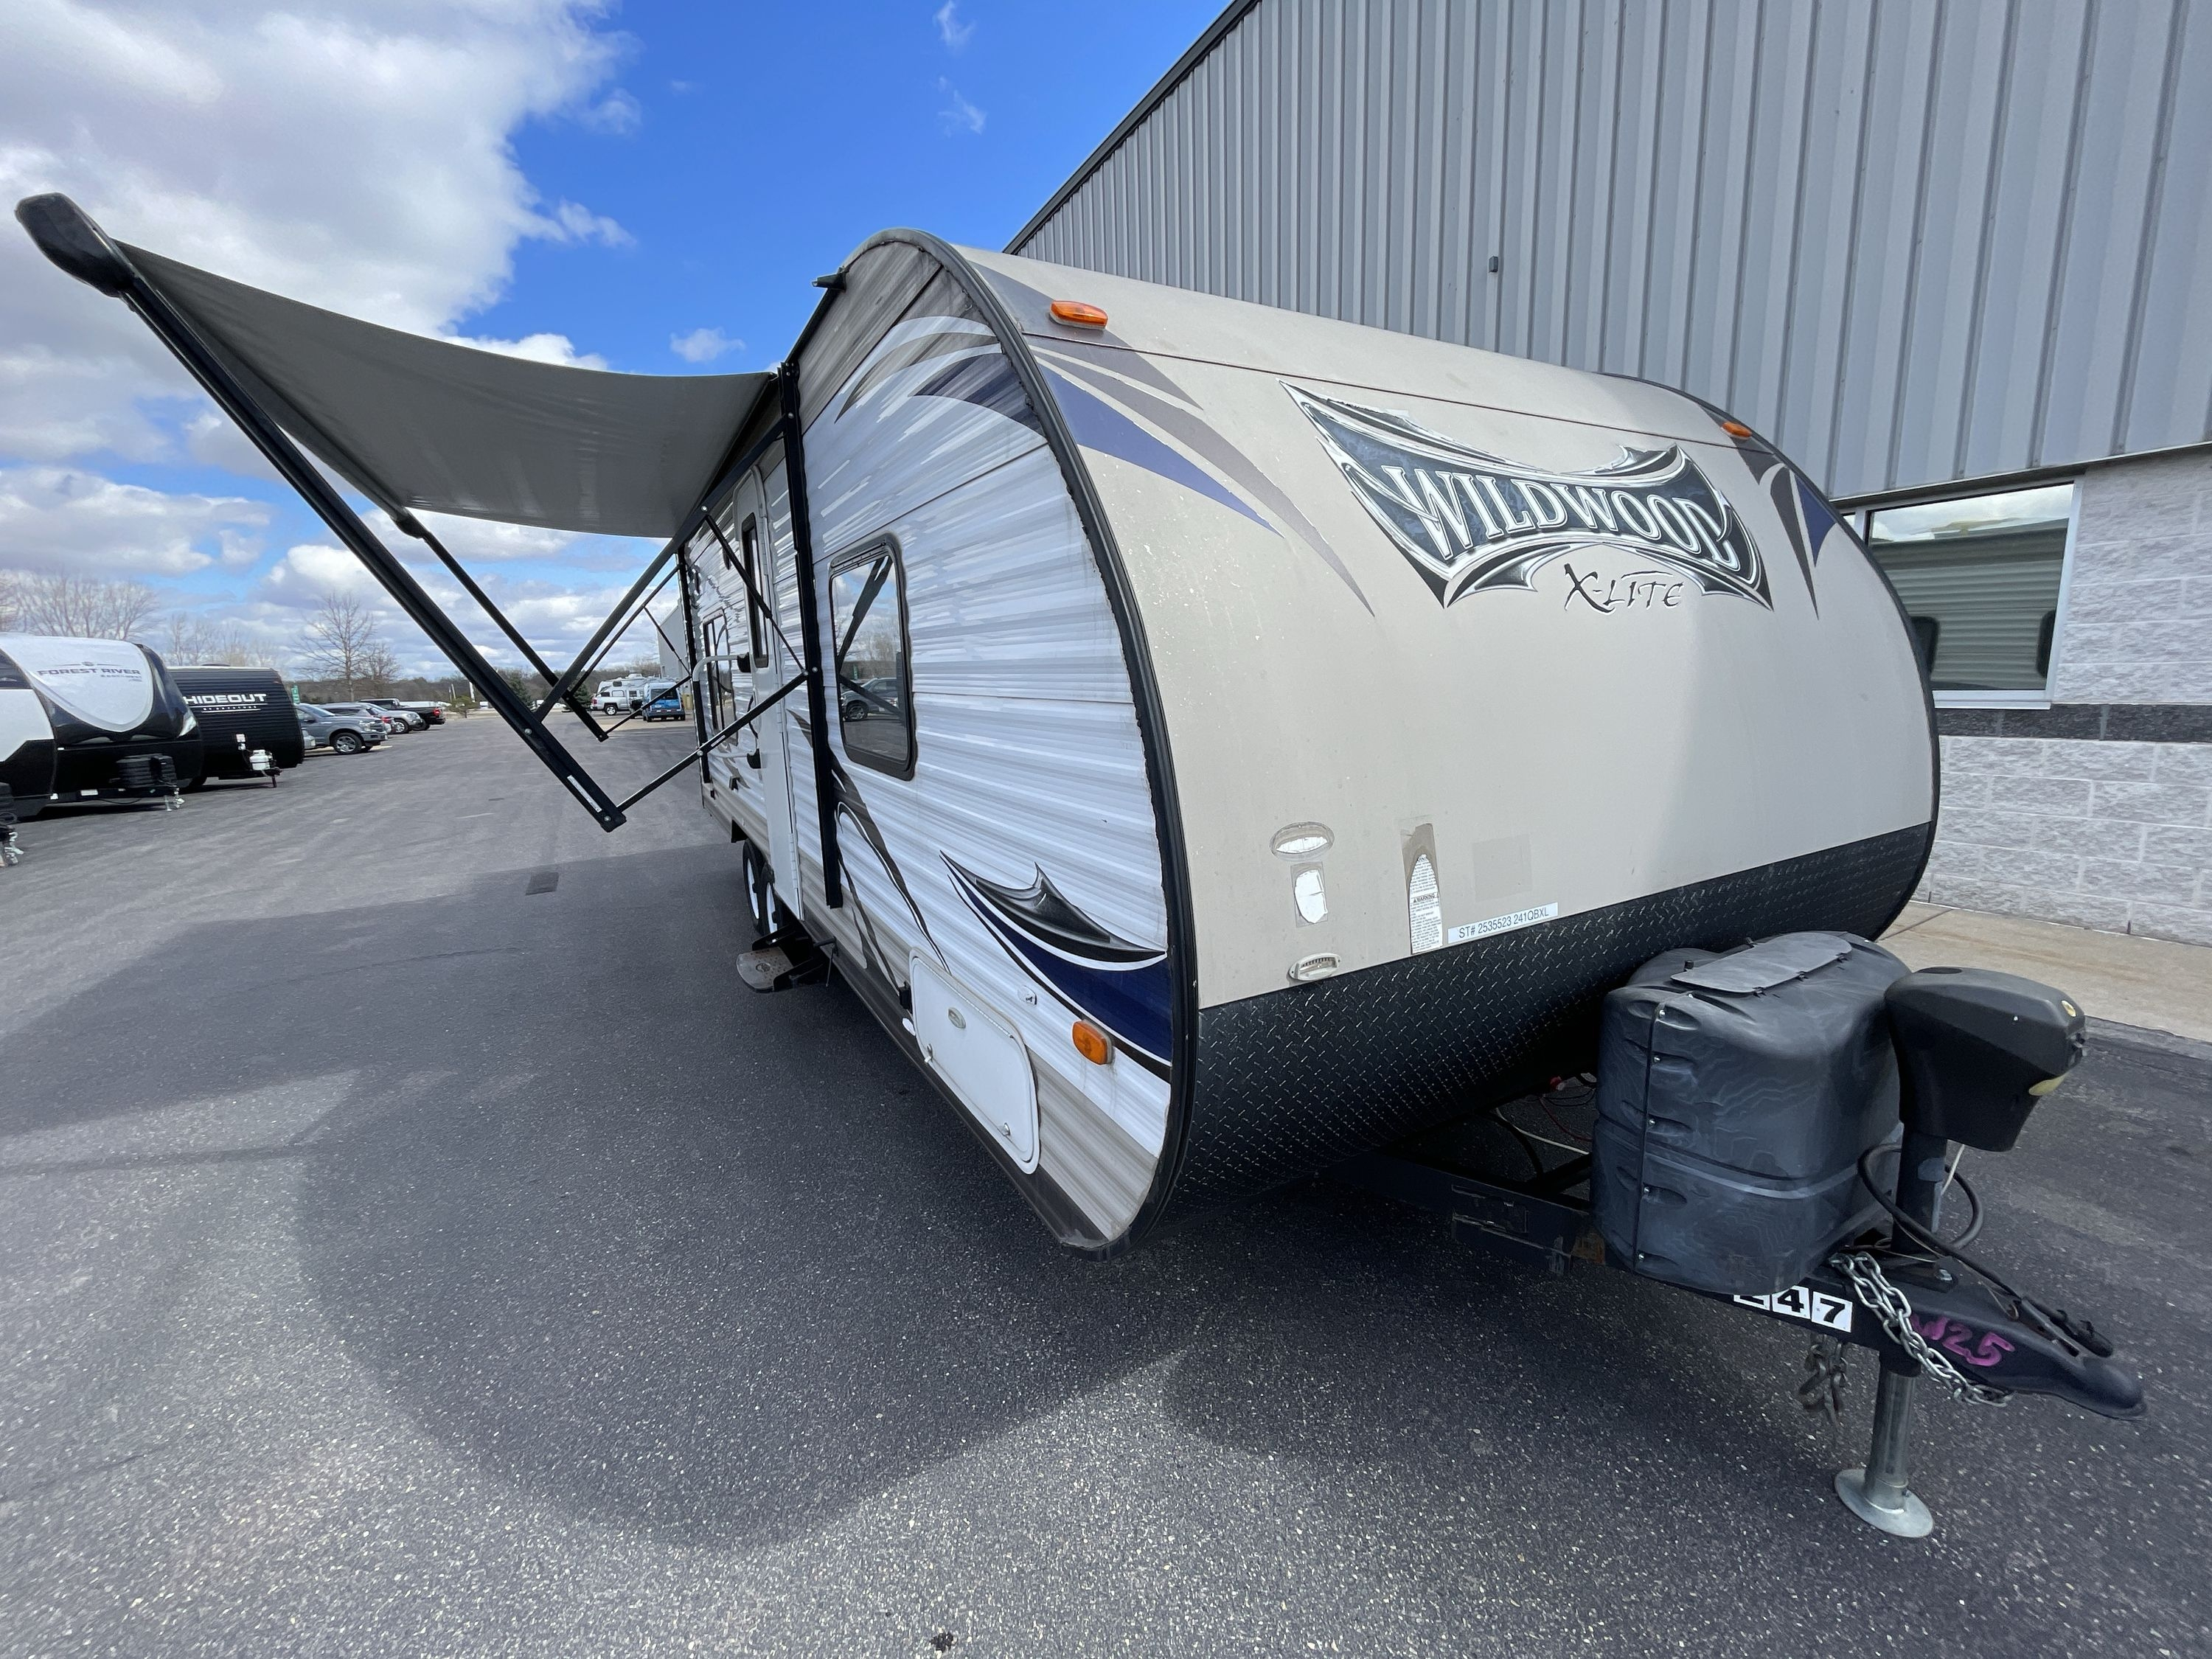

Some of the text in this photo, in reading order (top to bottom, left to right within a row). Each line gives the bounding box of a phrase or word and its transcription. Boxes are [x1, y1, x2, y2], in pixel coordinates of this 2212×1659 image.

[1381, 465, 1740, 572] WILDWOOD
[37, 668, 98, 676] FOREST
[183, 693, 267, 705] HIDEOUT
[1458, 906, 1549, 939] ST# 2535523 241QBXL
